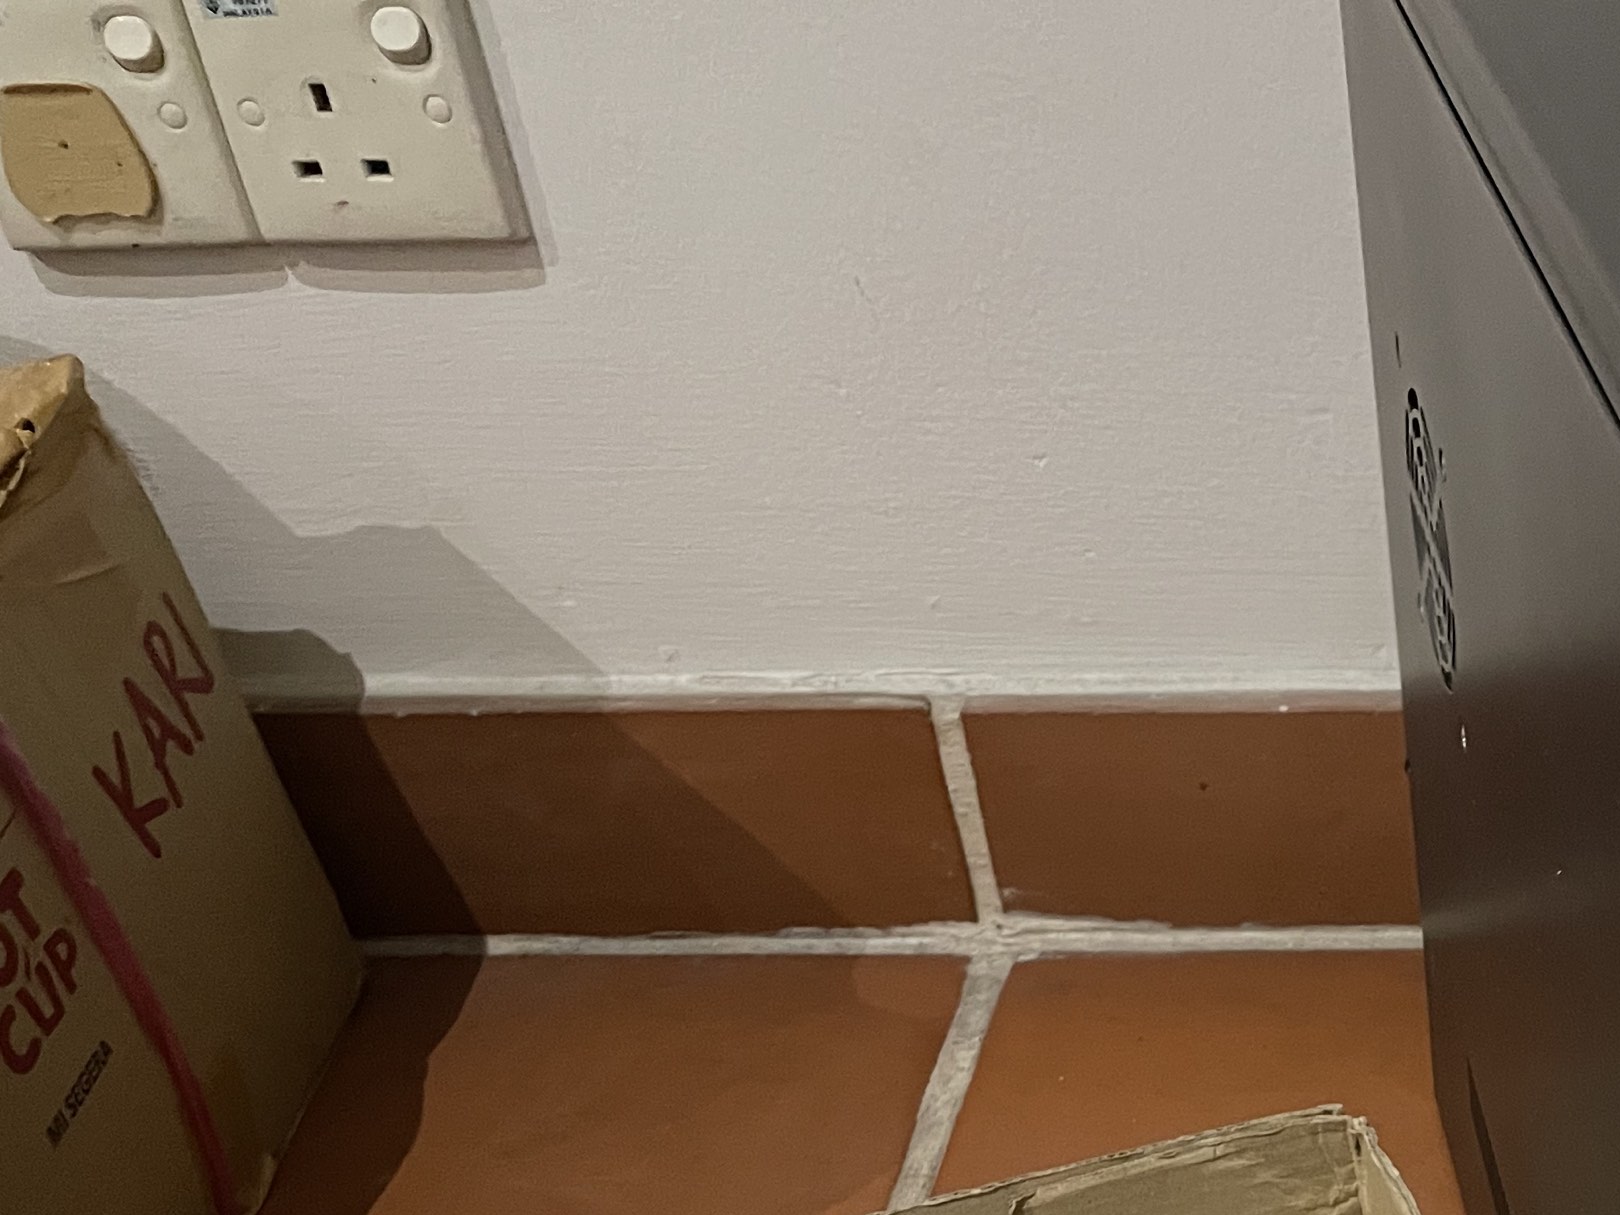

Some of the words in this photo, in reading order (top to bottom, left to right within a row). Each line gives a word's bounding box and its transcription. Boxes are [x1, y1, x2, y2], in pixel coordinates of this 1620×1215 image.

[92, 591, 215, 859] KARI
[0, 928, 78, 1075] CUP
[64, 1039, 114, 1120] SEGERA
